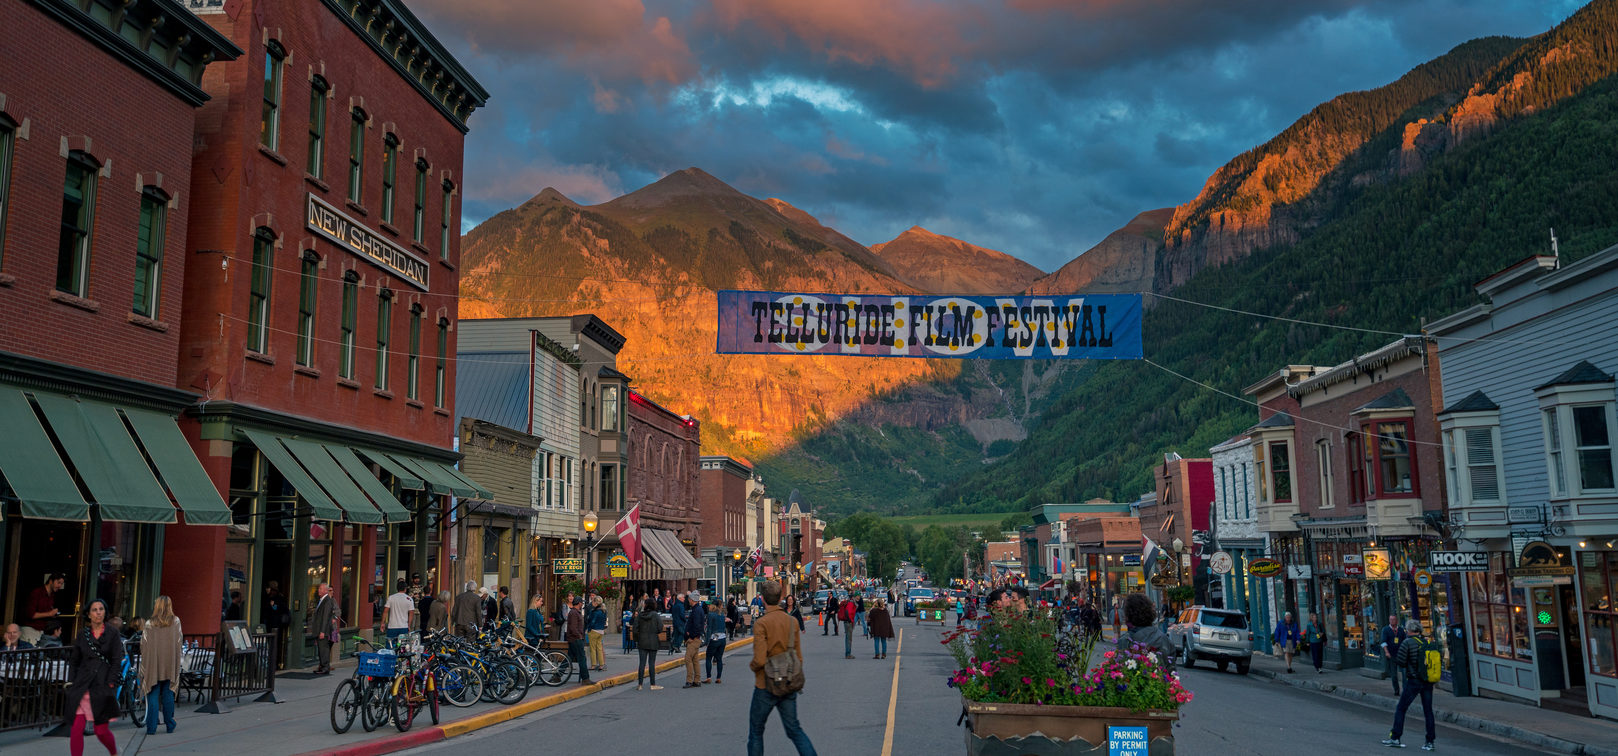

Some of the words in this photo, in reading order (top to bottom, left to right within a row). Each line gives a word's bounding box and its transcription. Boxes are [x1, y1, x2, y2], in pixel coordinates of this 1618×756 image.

[310, 201, 347, 241] NEW
[752, 301, 895, 346] TELLURIDE
[908, 305, 975, 347] FILM
[985, 305, 1112, 347] FESTIVAL
[1433, 553, 1477, 565] HOOK
[1249, 562, 1280, 573] Paradise
[1113, 731, 1143, 740] PARKING
[1110, 741, 1119, 750] BY
[1122, 741, 1147, 750] PERMIT
